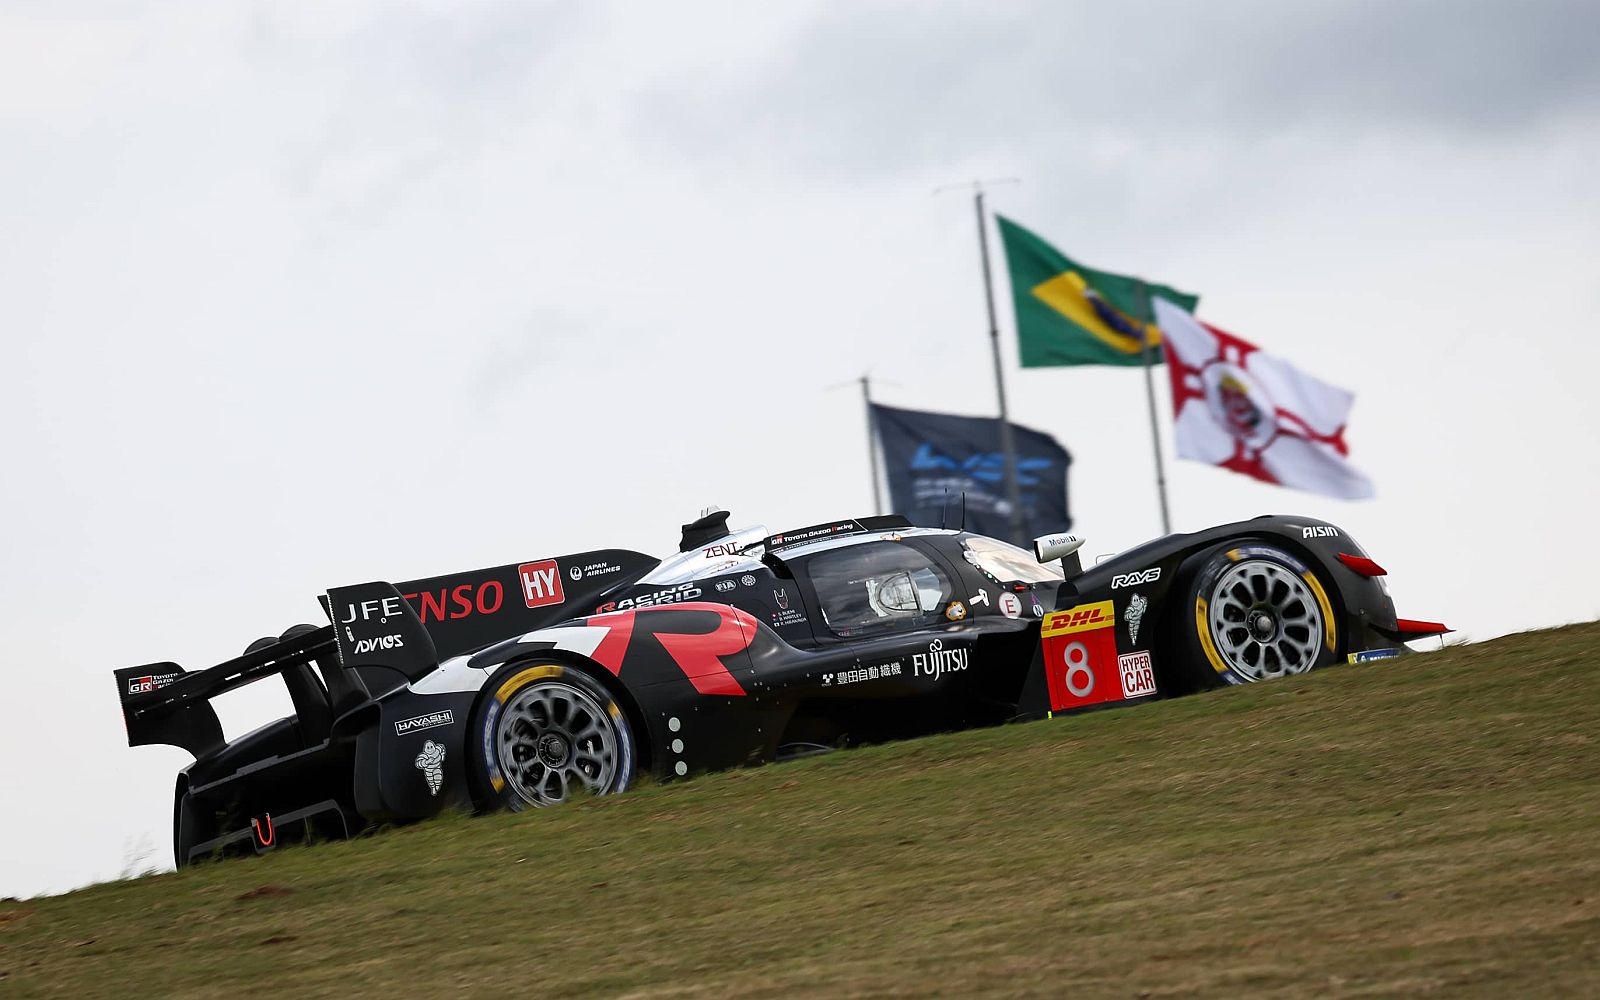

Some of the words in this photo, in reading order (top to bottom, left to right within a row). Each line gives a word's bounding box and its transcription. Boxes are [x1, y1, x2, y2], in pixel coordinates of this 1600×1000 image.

[783, 534, 808, 542] TOYOTA
[808, 528, 831, 537] GAZOO
[832, 524, 853, 532] Racing
[1049, 536, 1070, 546] Mobil
[1302, 526, 1339, 539] AISIN
[702, 541, 738, 559] ZENT
[583, 562, 607, 572] JAPAN
[586, 565, 621, 577] AIRLINES
[522, 567, 557, 601] HY
[716, 580, 736, 592] FIA
[1111, 567, 1161, 589] RAYS
[403, 580, 504, 624] NSO
[596, 582, 694, 614] RACING
[629, 588, 702, 610] BRID
[342, 596, 403, 623] JFE
[1051, 608, 1105, 630] DHL
[912, 641, 968, 681] FUJITSU
[1064, 641, 1095, 697] 8
[1121, 655, 1150, 672] HYPER
[130, 682, 151, 693] GR
[1124, 669, 1154, 693] CAR
[398, 713, 451, 731] HAYASHI
